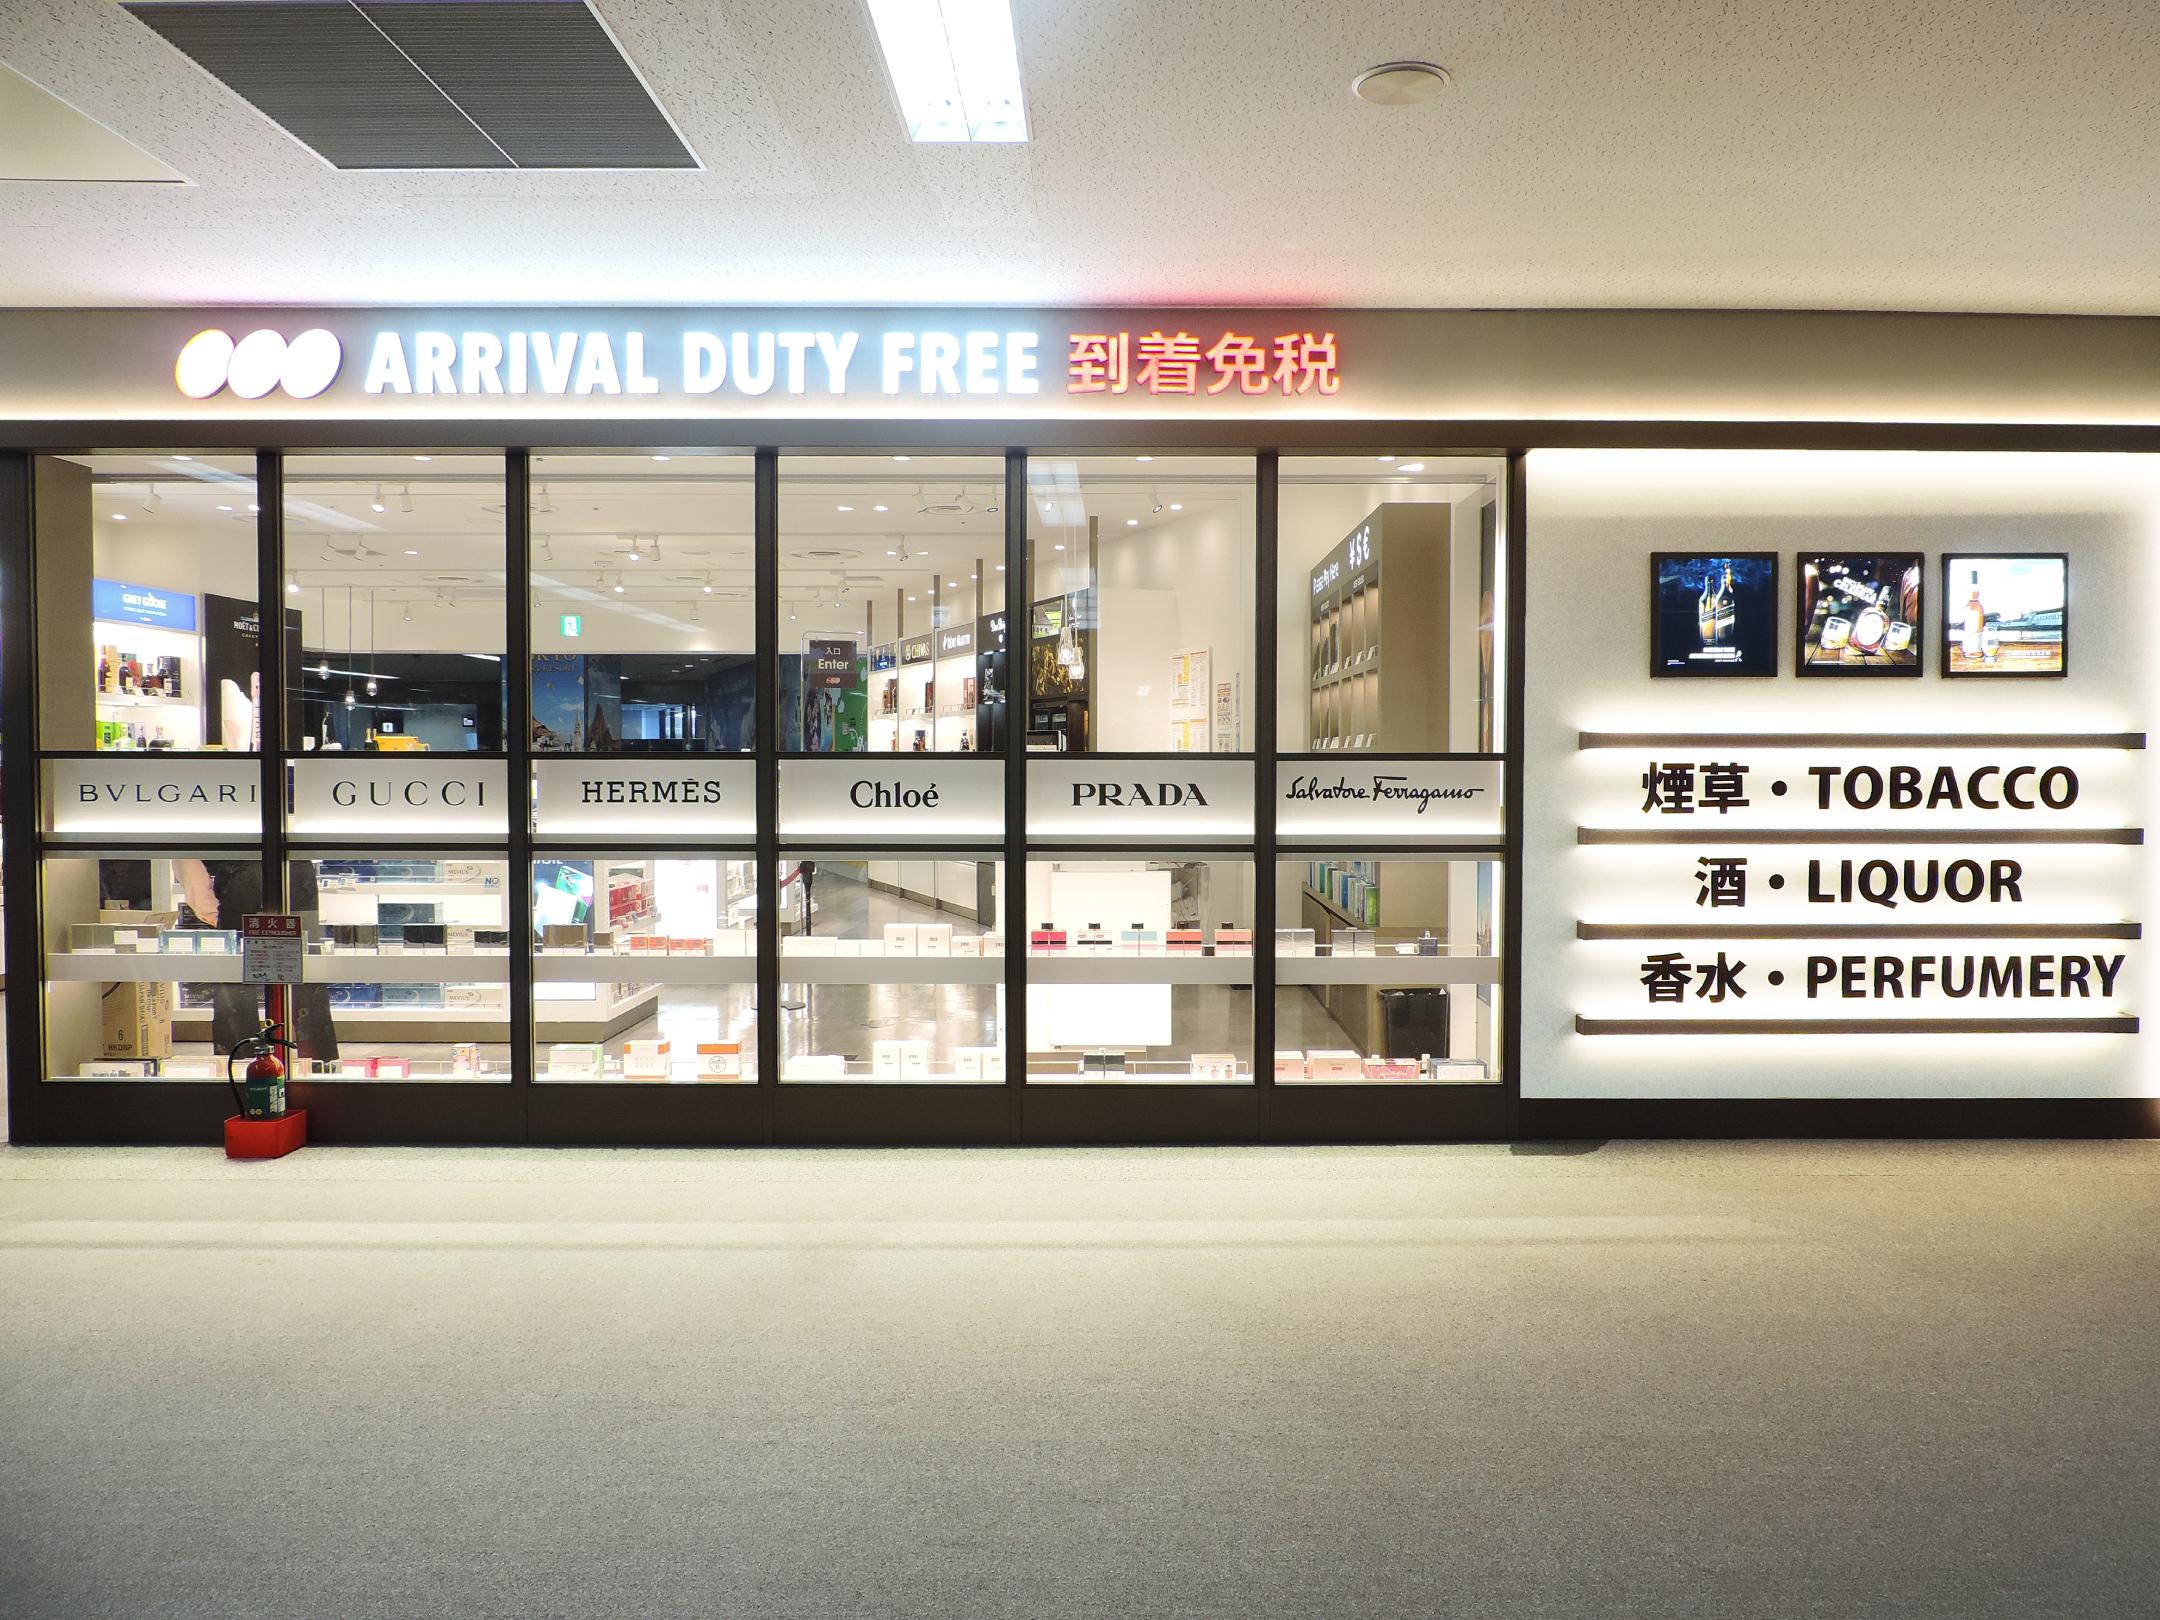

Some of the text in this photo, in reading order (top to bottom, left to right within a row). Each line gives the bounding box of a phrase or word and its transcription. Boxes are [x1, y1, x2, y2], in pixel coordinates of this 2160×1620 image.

[364, 330, 1341, 397] ARRIVAL DUTY FREE 到着免税
[817, 658, 849, 670] Enter
[824, 647, 841, 656] 入口
[78, 783, 258, 804] BVLGARI
[332, 780, 486, 807] GUCCI
[581, 777, 722, 804] HERMÈS
[849, 779, 940, 809] Chloé
[1071, 783, 1210, 807] PRADA
[1285, 775, 1485, 814] Salvatore Ferragamo
[1641, 761, 2080, 814] 煙草 TOBACCO
[1694, 856, 2024, 910] 酒 LIQUOR
[248, 917, 296, 929] 消火器
[1640, 951, 2126, 1003] 香水 PERFUMERY
